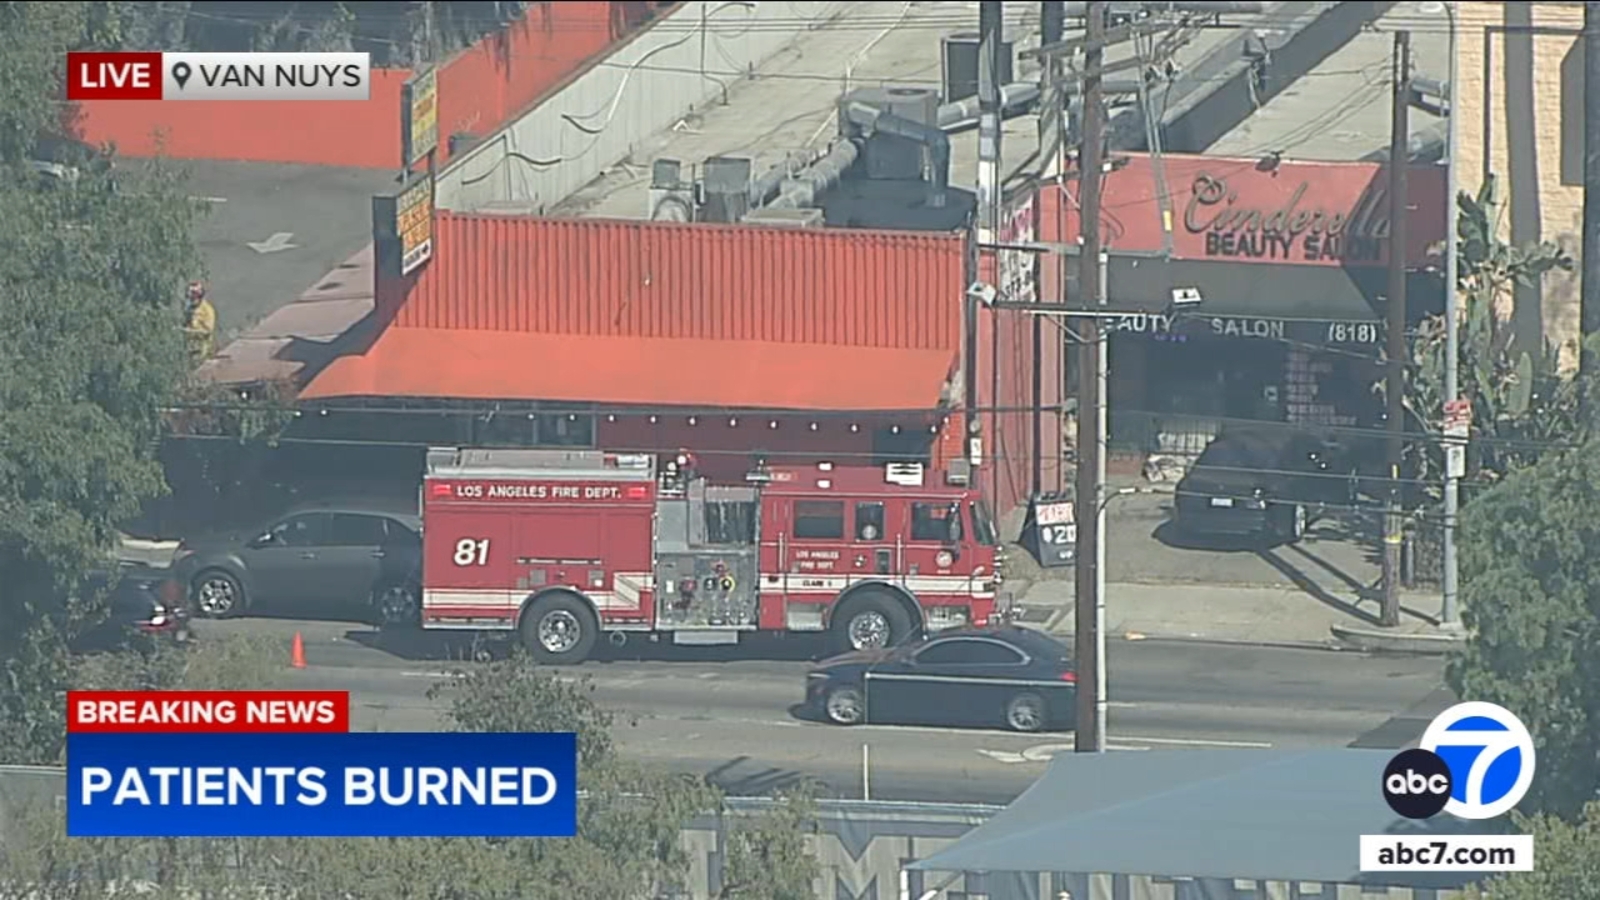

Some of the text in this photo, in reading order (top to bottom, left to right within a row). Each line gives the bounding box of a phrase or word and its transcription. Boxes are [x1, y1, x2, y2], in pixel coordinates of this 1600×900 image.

[1184, 172, 1389, 238] Cinderella
[1205, 231, 1381, 261] BEAUTY SALON
[1210, 318, 1284, 338] SALON
[1328, 322, 1377, 343] (818)
[457, 485, 622, 499] LOS ANGELES FIRE DEPT.
[453, 538, 491, 566] 81
